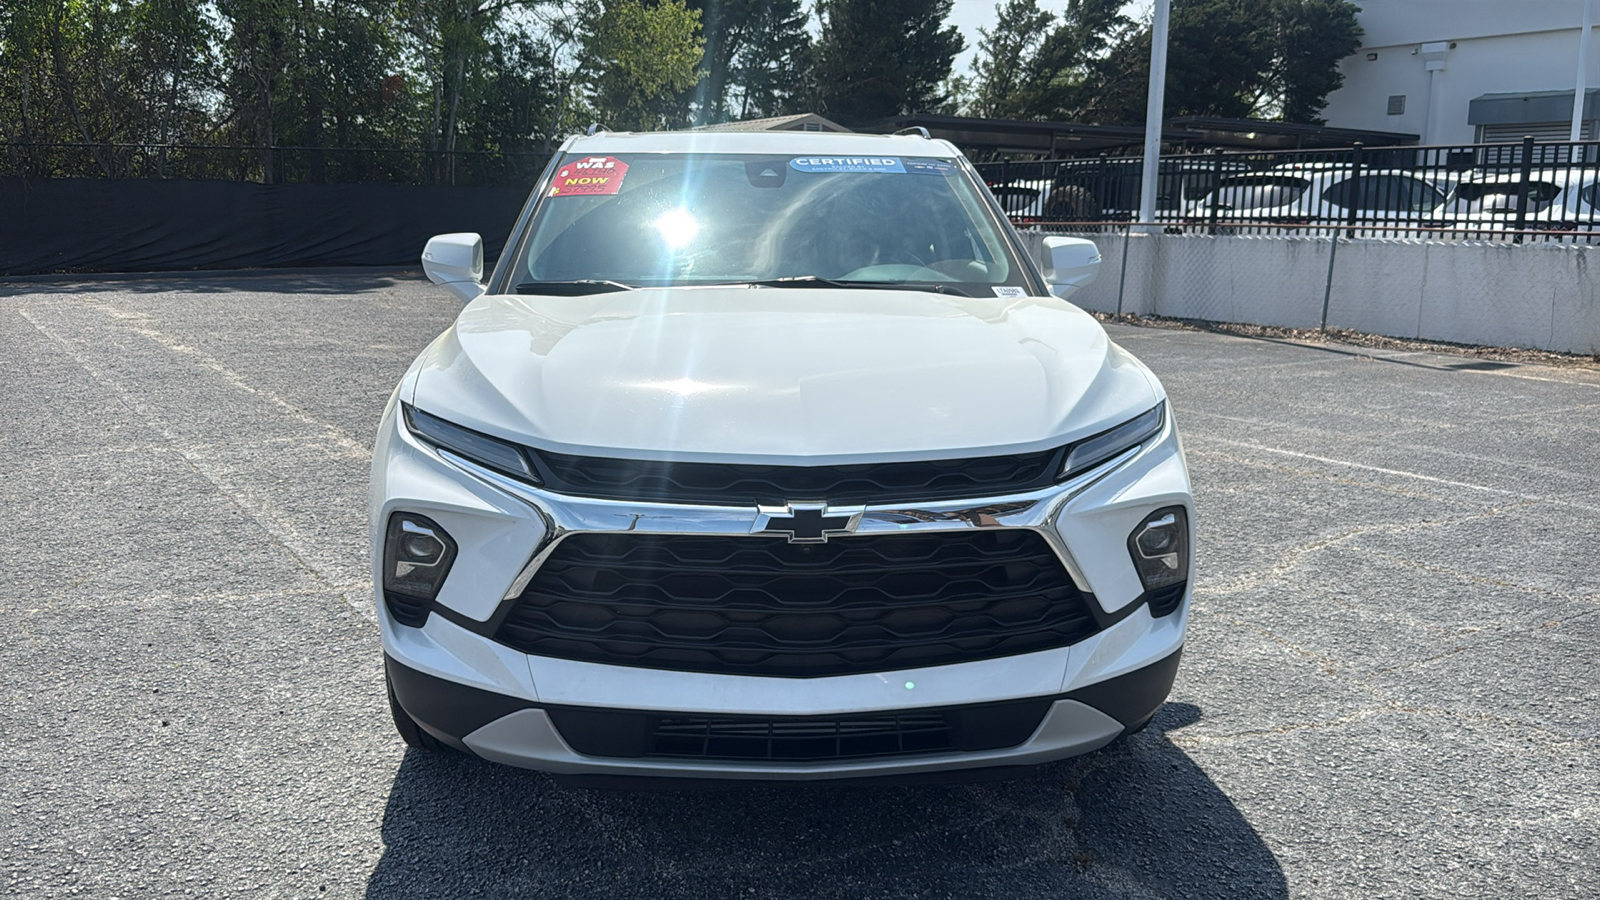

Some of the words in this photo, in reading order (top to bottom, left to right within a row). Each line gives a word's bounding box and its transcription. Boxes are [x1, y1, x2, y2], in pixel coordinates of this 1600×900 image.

[576, 161, 615, 169] WAS
[795, 158, 896, 166] CERTIFIED
[564, 177, 610, 185] NOW
